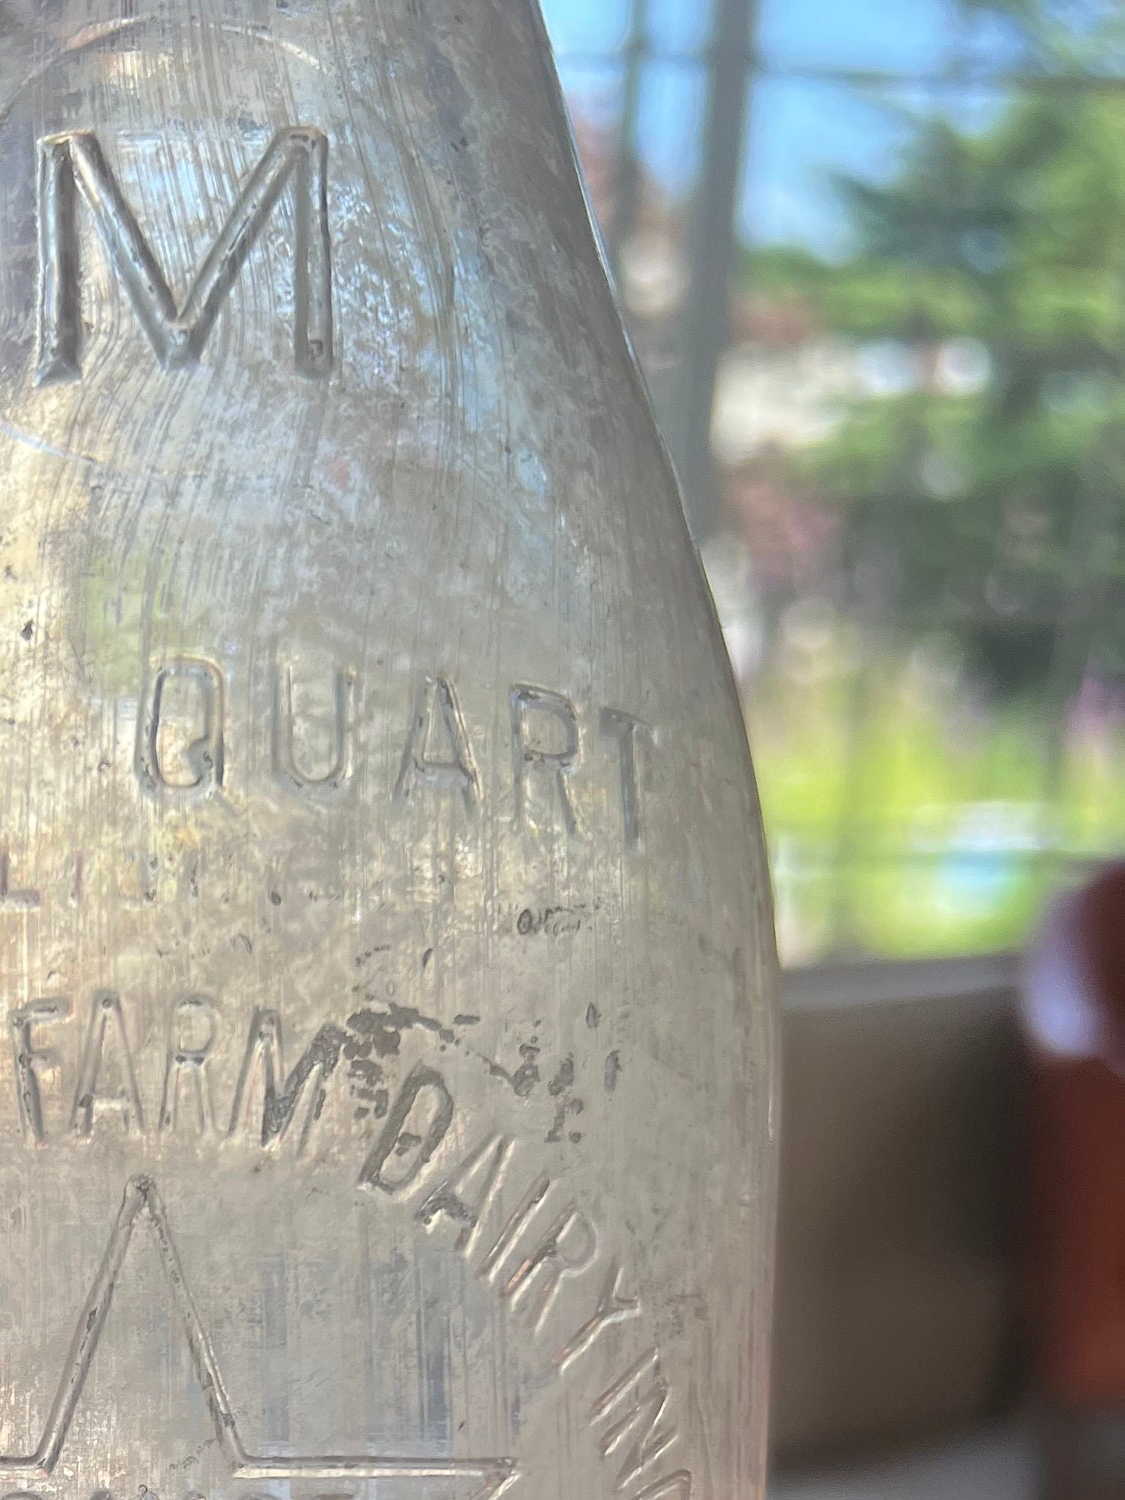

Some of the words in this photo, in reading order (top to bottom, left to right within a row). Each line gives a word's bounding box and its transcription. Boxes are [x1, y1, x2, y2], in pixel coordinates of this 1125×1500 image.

[36, 126, 334, 388] M
[134, 655, 660, 851] QUART
[9, 996, 349, 1160] FARM
[358, 1062, 642, 1374] DAIRY
